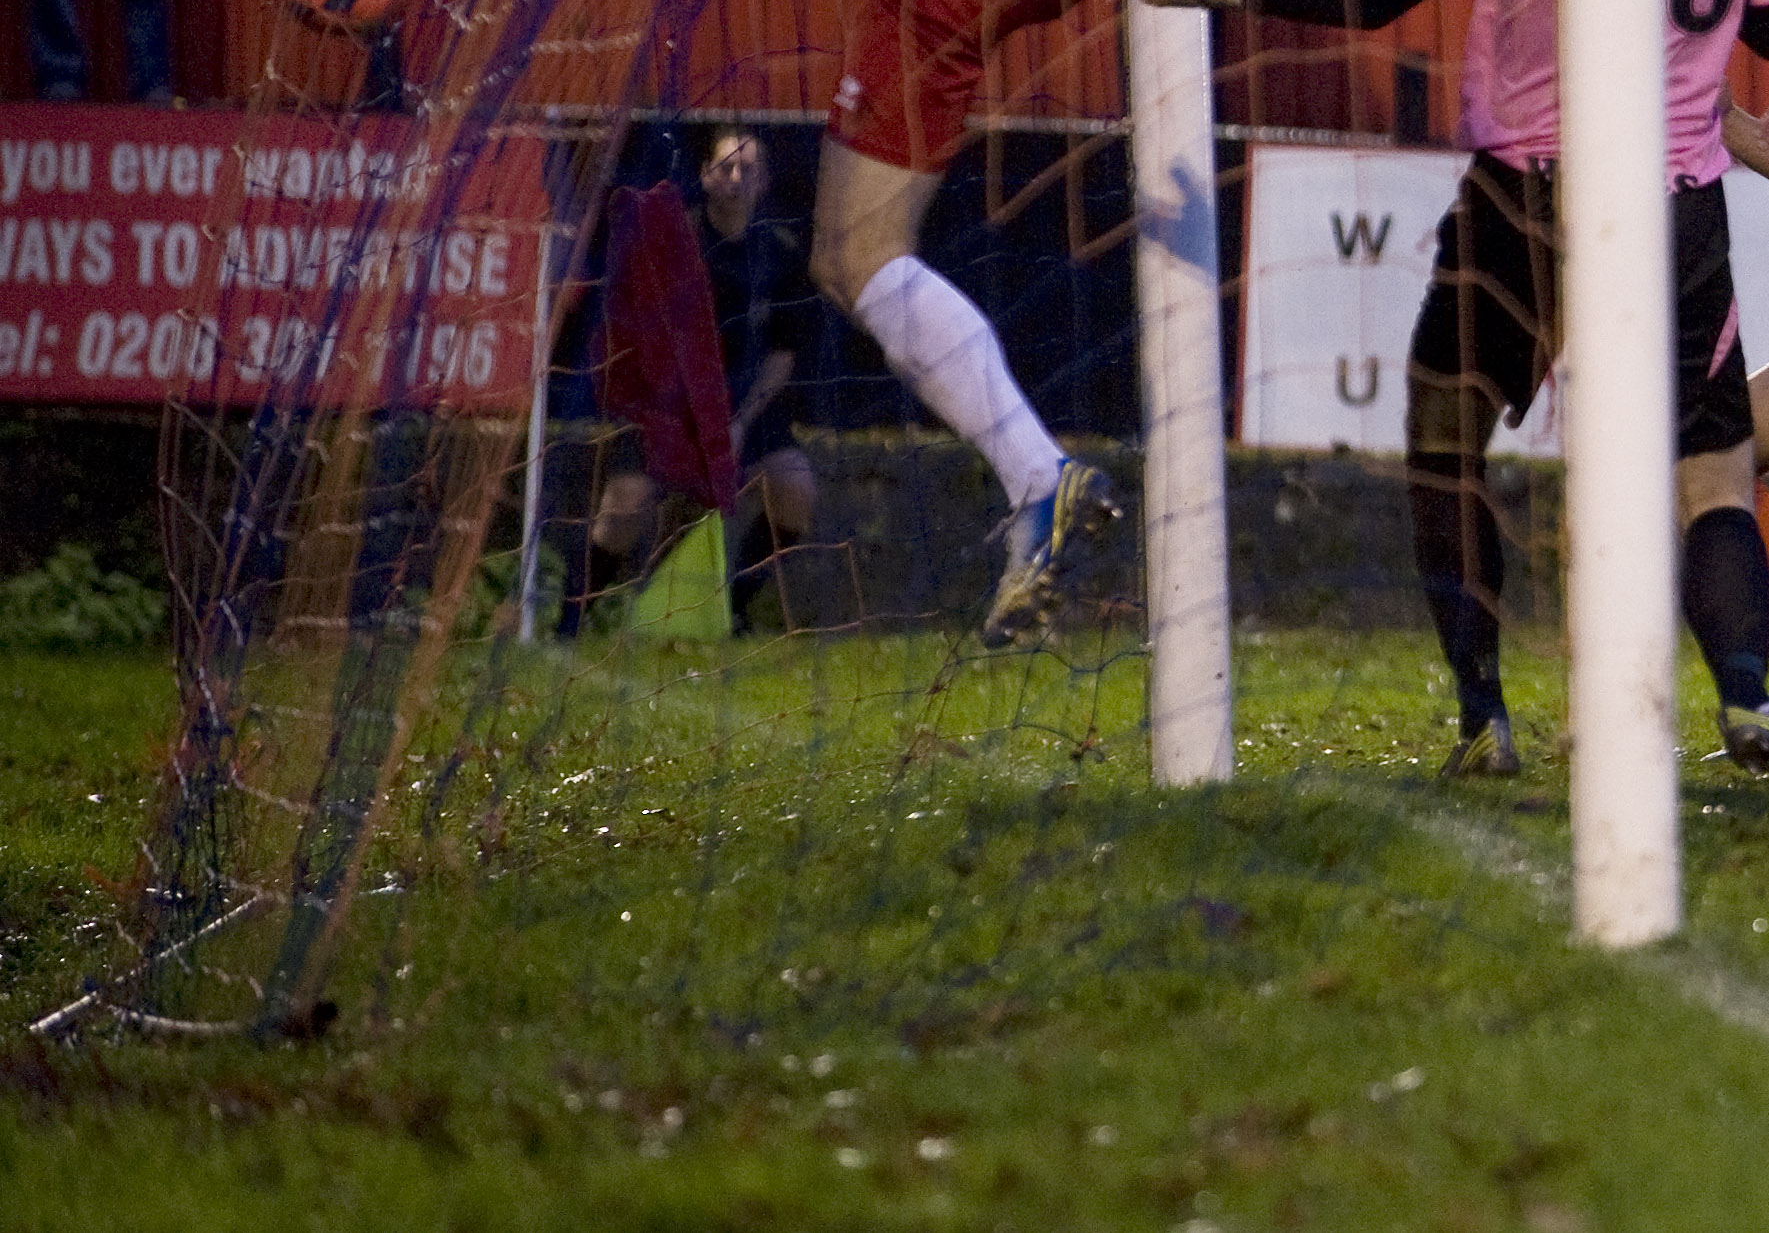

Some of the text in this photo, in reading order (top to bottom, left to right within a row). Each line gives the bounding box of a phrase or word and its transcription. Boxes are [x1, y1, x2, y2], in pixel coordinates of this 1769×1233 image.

[1, 140, 92, 205] you
[109, 142, 223, 197] ever
[131, 219, 199, 289] TO
[1330, 211, 1394, 263] W
[0, 309, 60, 379] el:
[1335, 354, 1380, 406] U
